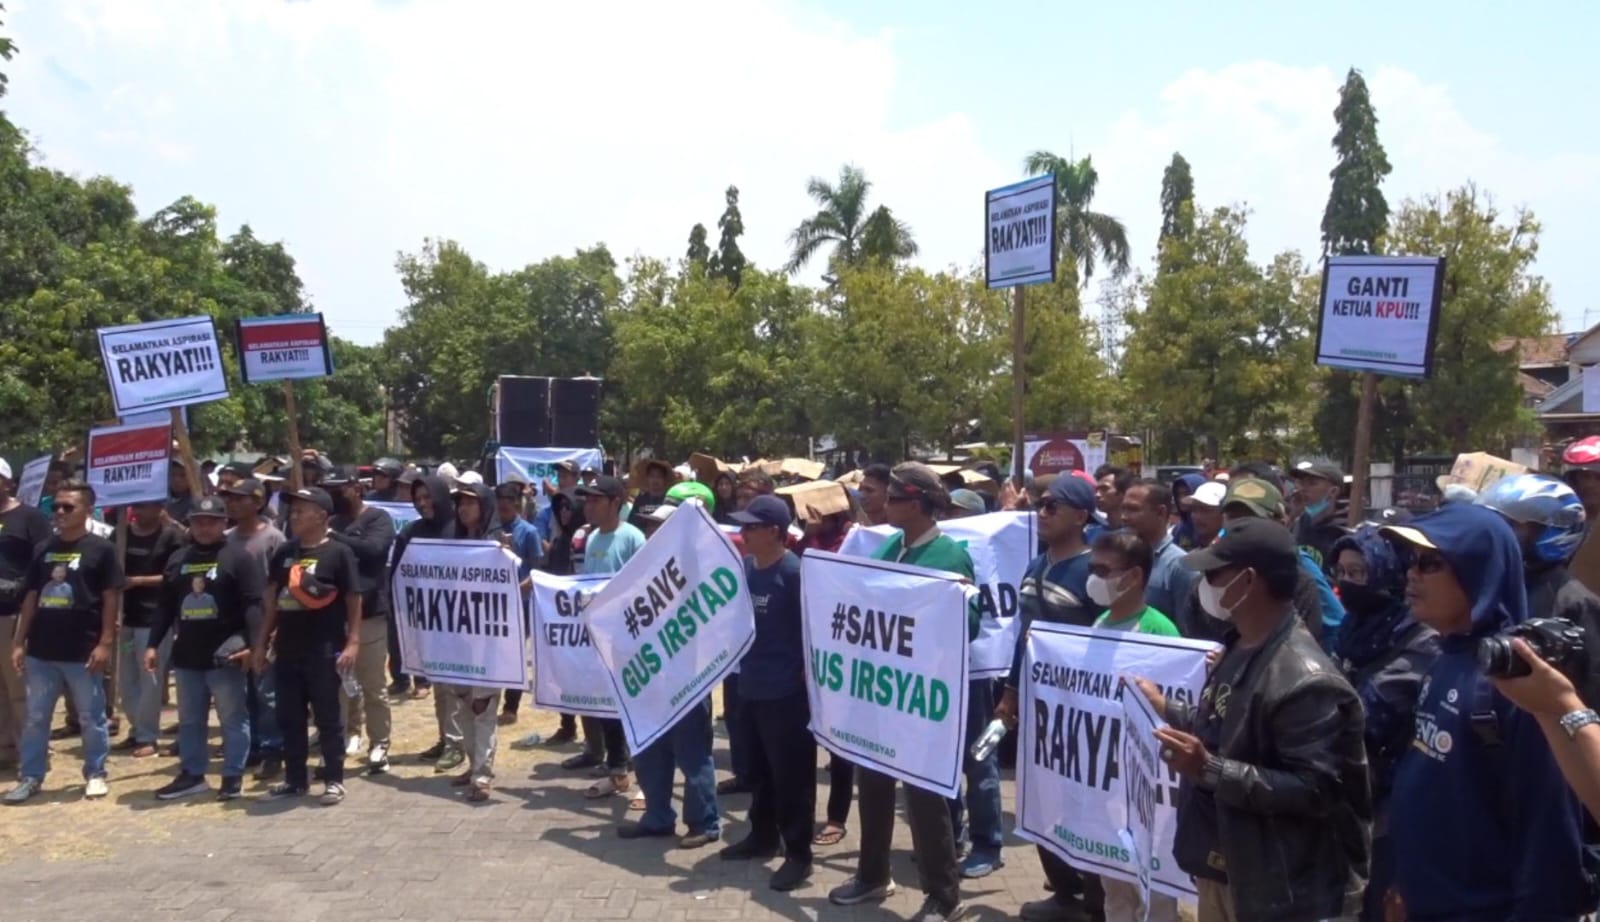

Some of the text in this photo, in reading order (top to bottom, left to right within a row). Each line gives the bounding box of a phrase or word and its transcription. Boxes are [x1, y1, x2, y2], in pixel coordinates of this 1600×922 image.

[991, 214, 1047, 254] RAKYAT!!!
[1347, 276, 1409, 298] GANTI
[1332, 299, 1420, 320] KETUA KPU!!!
[111, 332, 212, 354] SELAMATKAN ASPIRASI
[260, 348, 310, 364] RAKYAT!!!
[116, 345, 215, 384] RAKYAT!!!
[104, 462, 153, 484] RAKYAT!!!
[528, 462, 556, 477] #SA
[400, 563, 511, 584] SELAMATKAN ASPIRASI
[405, 586, 509, 637] RAKYAT!!!
[623, 556, 687, 640] #SAVE
[622, 566, 739, 698] GUS IRSYAD
[831, 602, 915, 658] #SAVE
[811, 645, 950, 722] US IRSYAD
[1032, 661, 1113, 699] SELAMATKAN
[1053, 823, 1160, 871] #SAVEGUSIRSD
